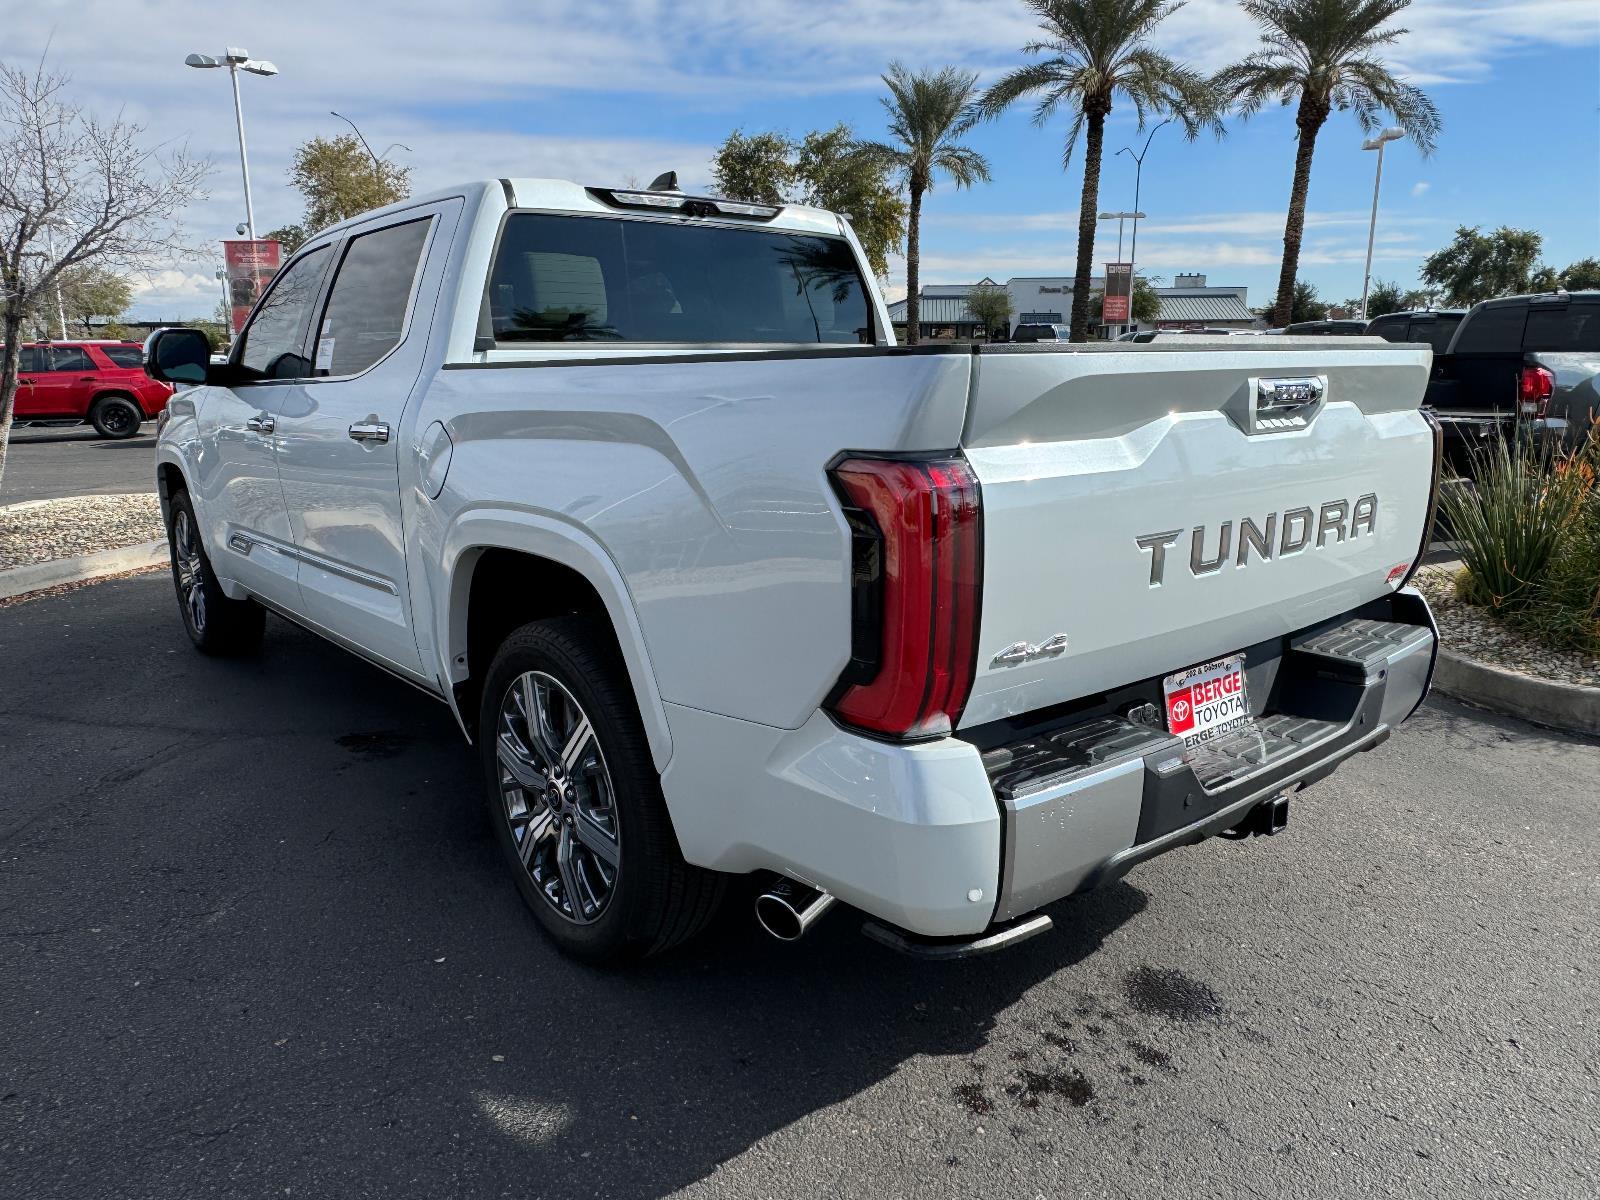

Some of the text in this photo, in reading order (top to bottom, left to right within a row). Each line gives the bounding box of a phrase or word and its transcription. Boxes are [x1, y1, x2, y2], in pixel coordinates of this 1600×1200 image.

[1135, 492, 1378, 588] TUNDRA
[1192, 671, 1242, 706] BERGE
[1195, 696, 1244, 725] TOYOTA
[1184, 715, 1250, 748] ERGE TOYOTA
